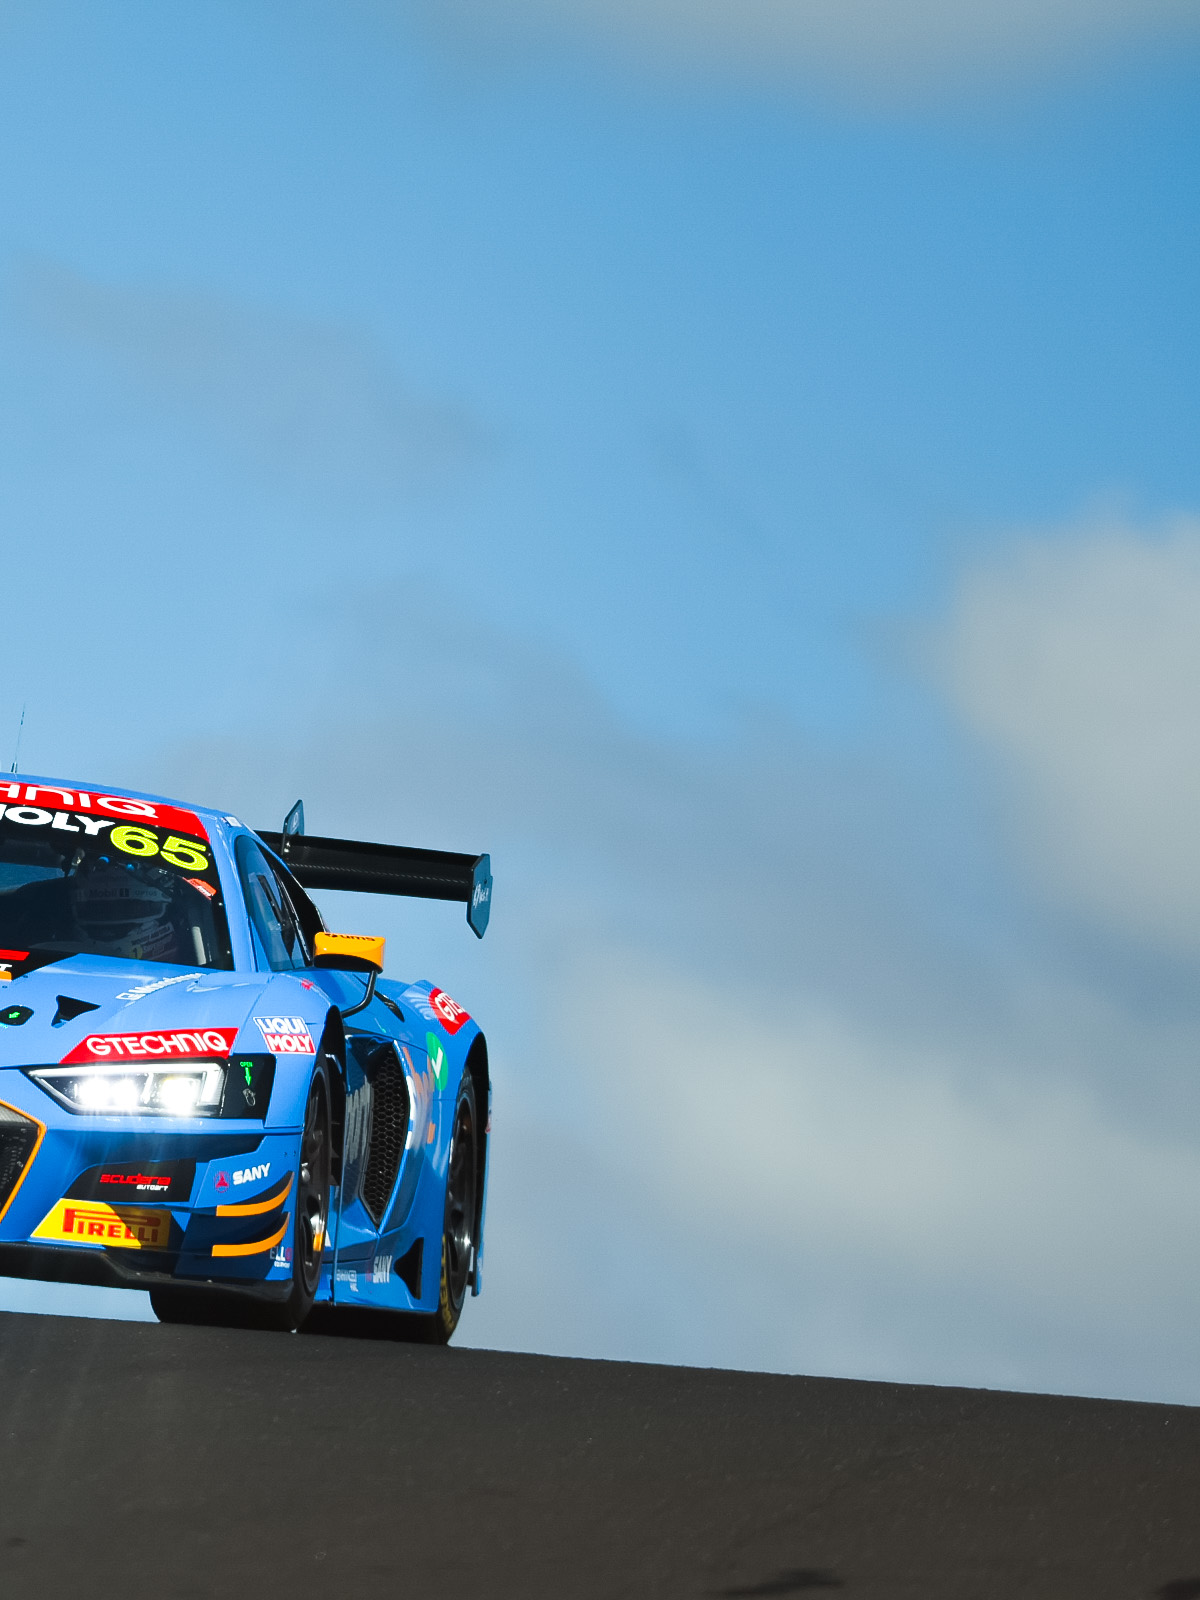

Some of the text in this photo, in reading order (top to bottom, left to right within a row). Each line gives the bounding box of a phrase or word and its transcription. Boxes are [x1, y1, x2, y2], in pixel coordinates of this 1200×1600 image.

[109, 825, 209, 871] 65
[257, 1017, 308, 1035] LIQUI
[86, 1031, 229, 1056] GTECHNIQ
[266, 1034, 313, 1053] MOLY
[232, 1162, 271, 1186] SANY
[62, 1208, 161, 1243] PIRELLI
